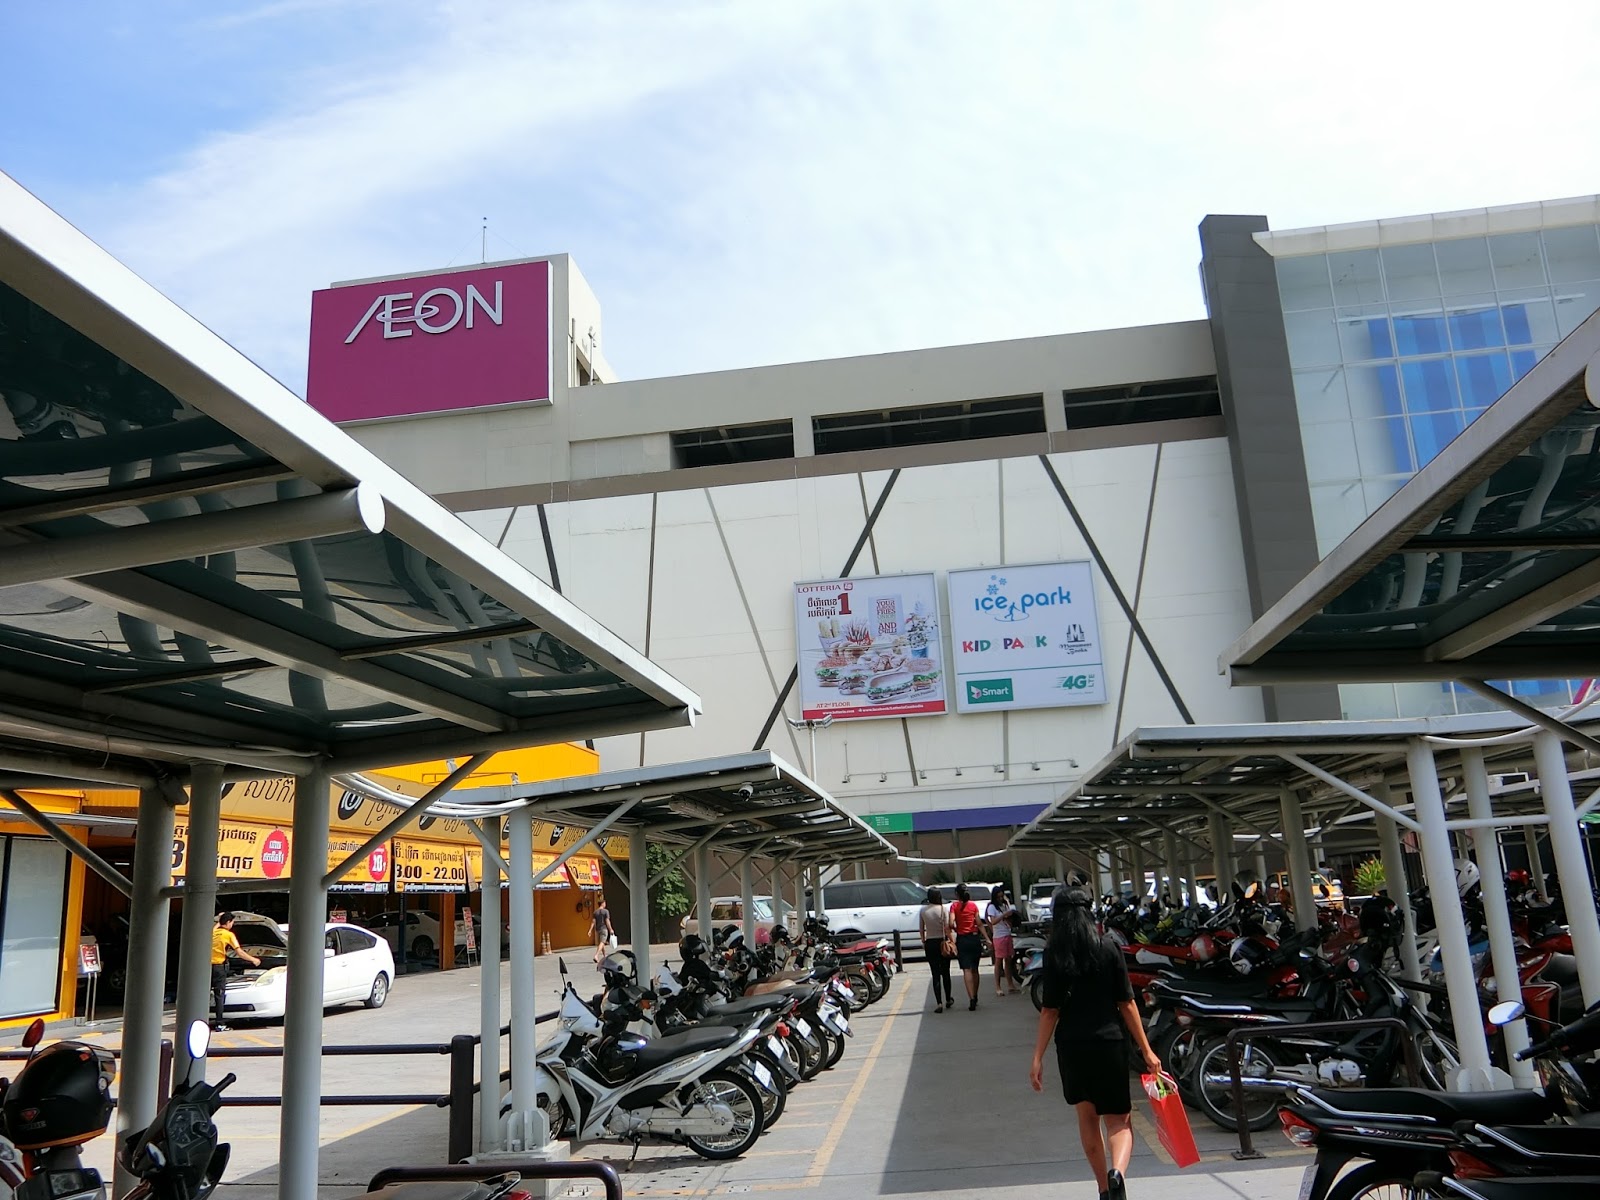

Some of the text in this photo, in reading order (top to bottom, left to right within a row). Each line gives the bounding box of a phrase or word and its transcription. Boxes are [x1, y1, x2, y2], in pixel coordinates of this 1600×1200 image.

[798, 584, 842, 594] LOTTERIA
[1021, 586, 1071, 613] park
[878, 622, 897, 631] AND
[1003, 635, 1048, 650] PAK
[1062, 674, 1087, 690] 4G
[982, 687, 1009, 696] Smart
[433, 866, 465, 880] 22.00
